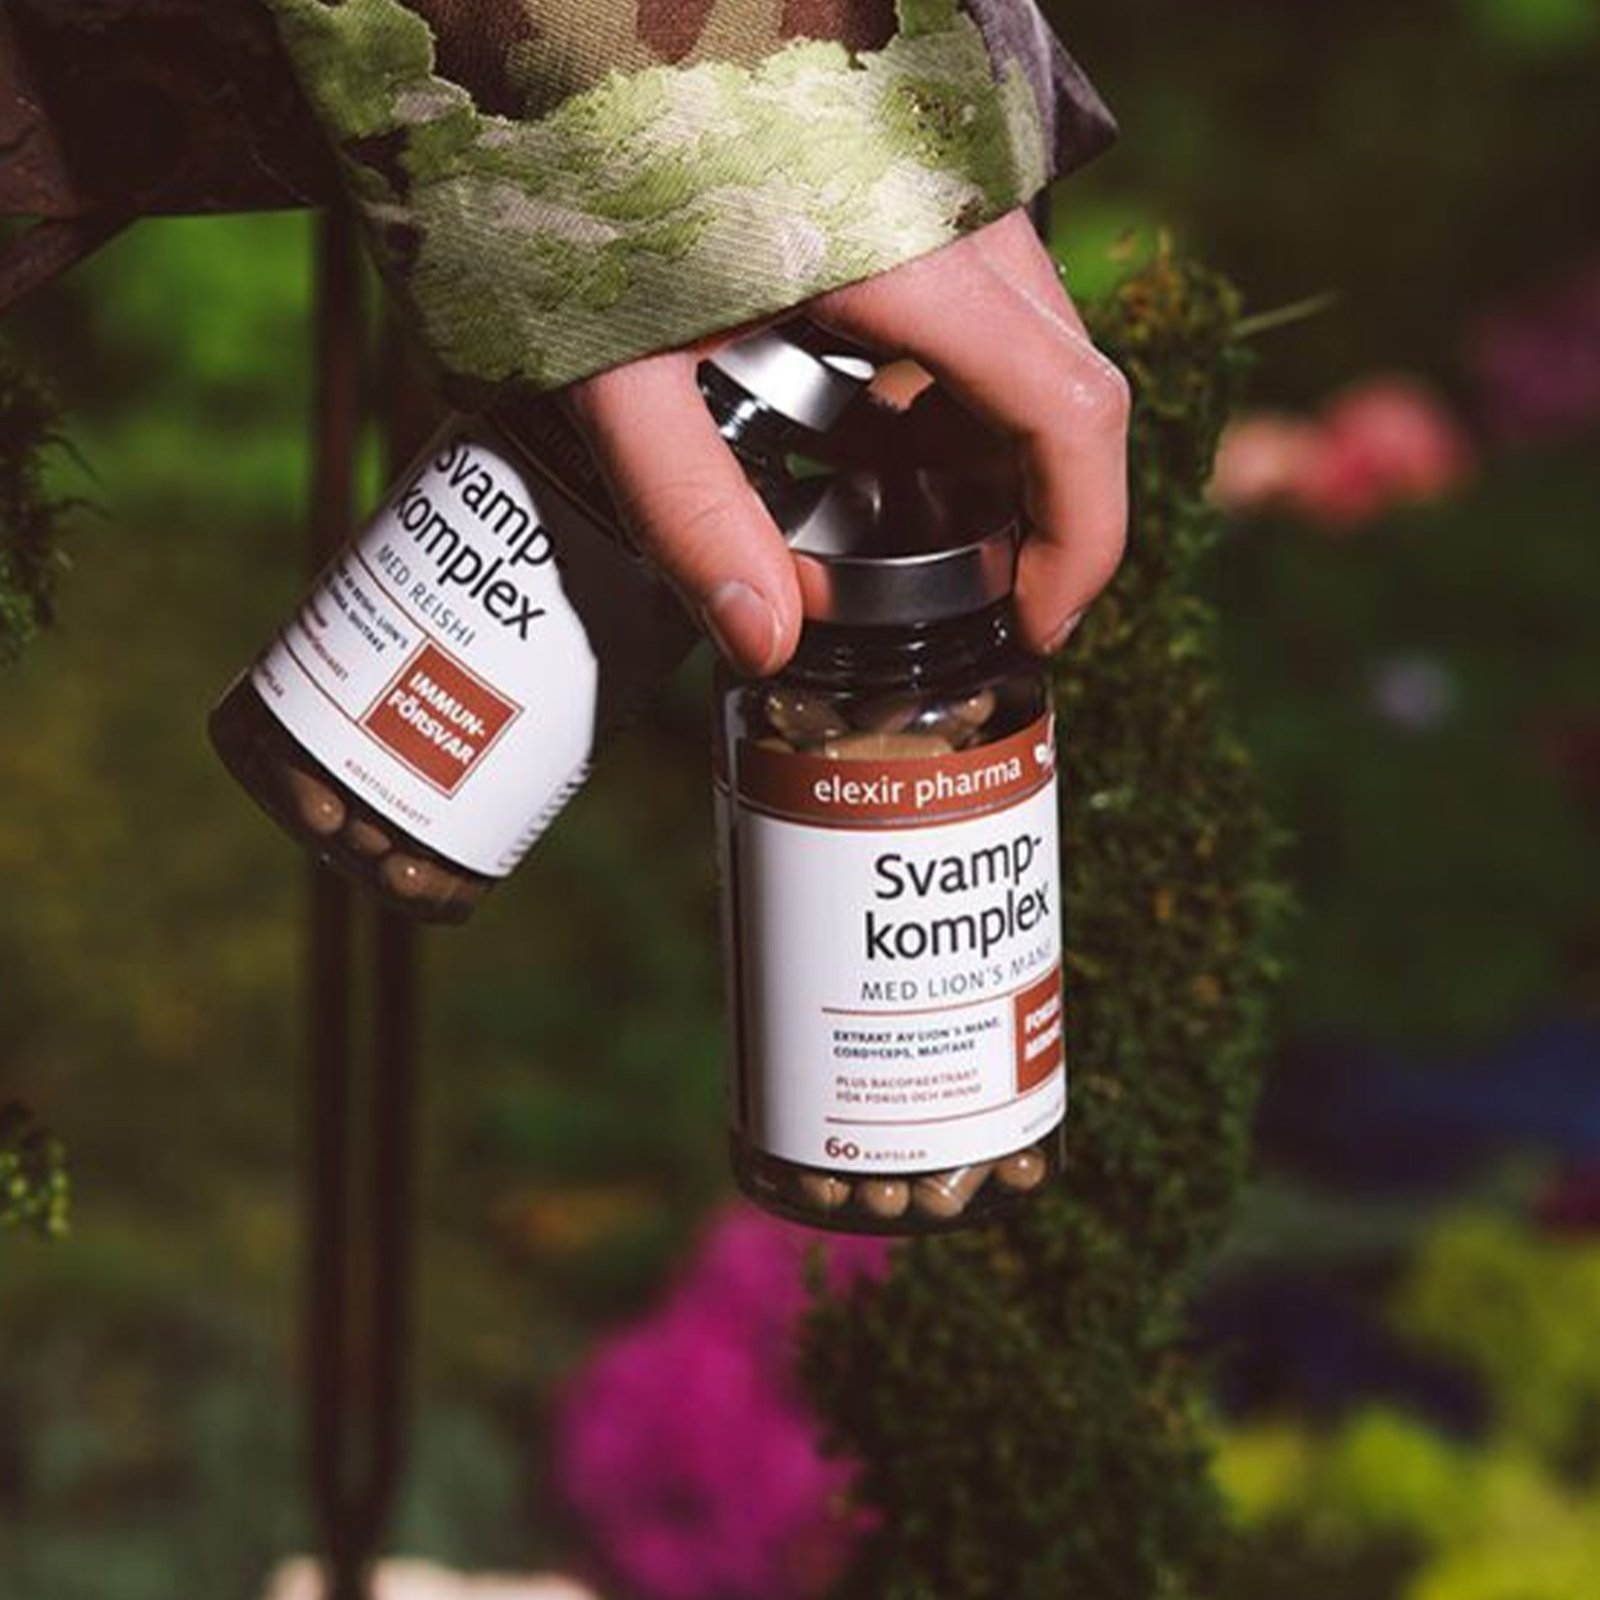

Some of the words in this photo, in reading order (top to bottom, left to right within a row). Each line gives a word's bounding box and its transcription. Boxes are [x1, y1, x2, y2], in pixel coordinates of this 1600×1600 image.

[391, 466, 546, 641] komplex
[377, 544, 410, 586] MED
[408, 581, 477, 648] REISHI
[386, 688, 475, 765] FÖRSVAR
[407, 671, 486, 736] IMMUN-
[813, 775, 903, 804] elexir
[914, 757, 1022, 809] pharma
[874, 833, 1042, 900] Svamp-
[864, 880, 1050, 961] komplex
[860, 981, 918, 1002] MED
[927, 965, 1002, 998] LION'S
[833, 1029, 892, 1044] EXTRAKT
[896, 1030, 915, 1043] AV
[917, 1039, 976, 1057] MAITAKE
[835, 1075, 868, 1089] PLUS
[824, 1136, 861, 1161] 60
